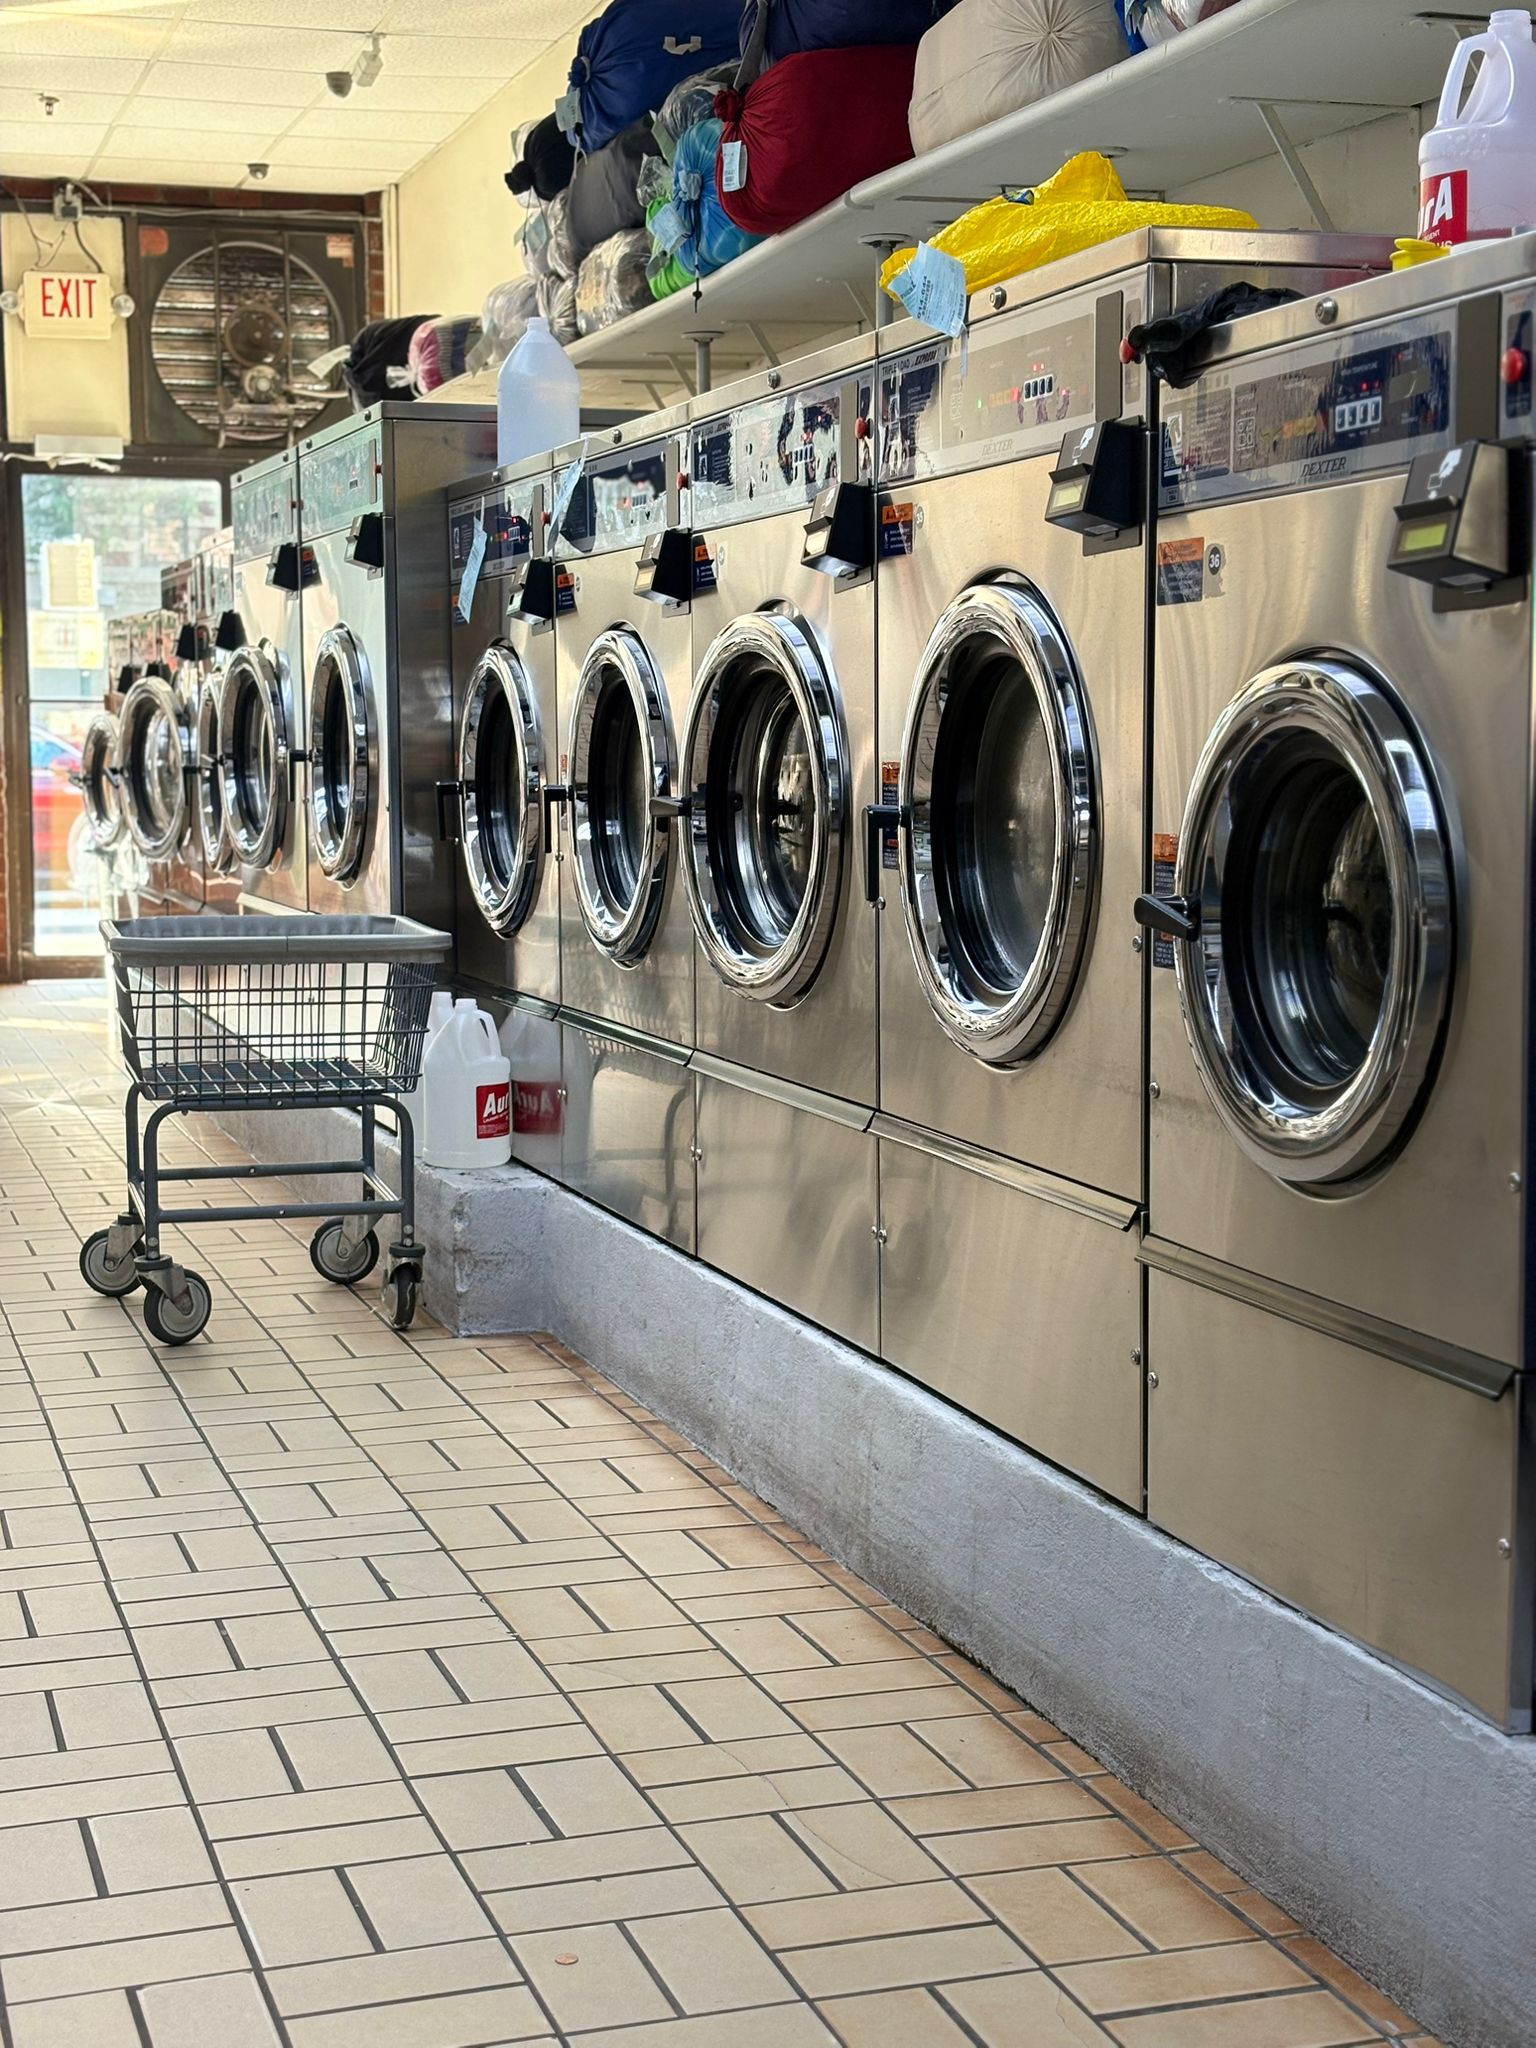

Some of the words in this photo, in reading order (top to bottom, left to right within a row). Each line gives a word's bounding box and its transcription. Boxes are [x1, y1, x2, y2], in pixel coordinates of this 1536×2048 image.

[41, 278, 97, 319] EXIT
[982, 438, 1013, 457] DEXTER
[1301, 456, 1347, 478] DEXTER
[1209, 554, 1220, 568] 36
